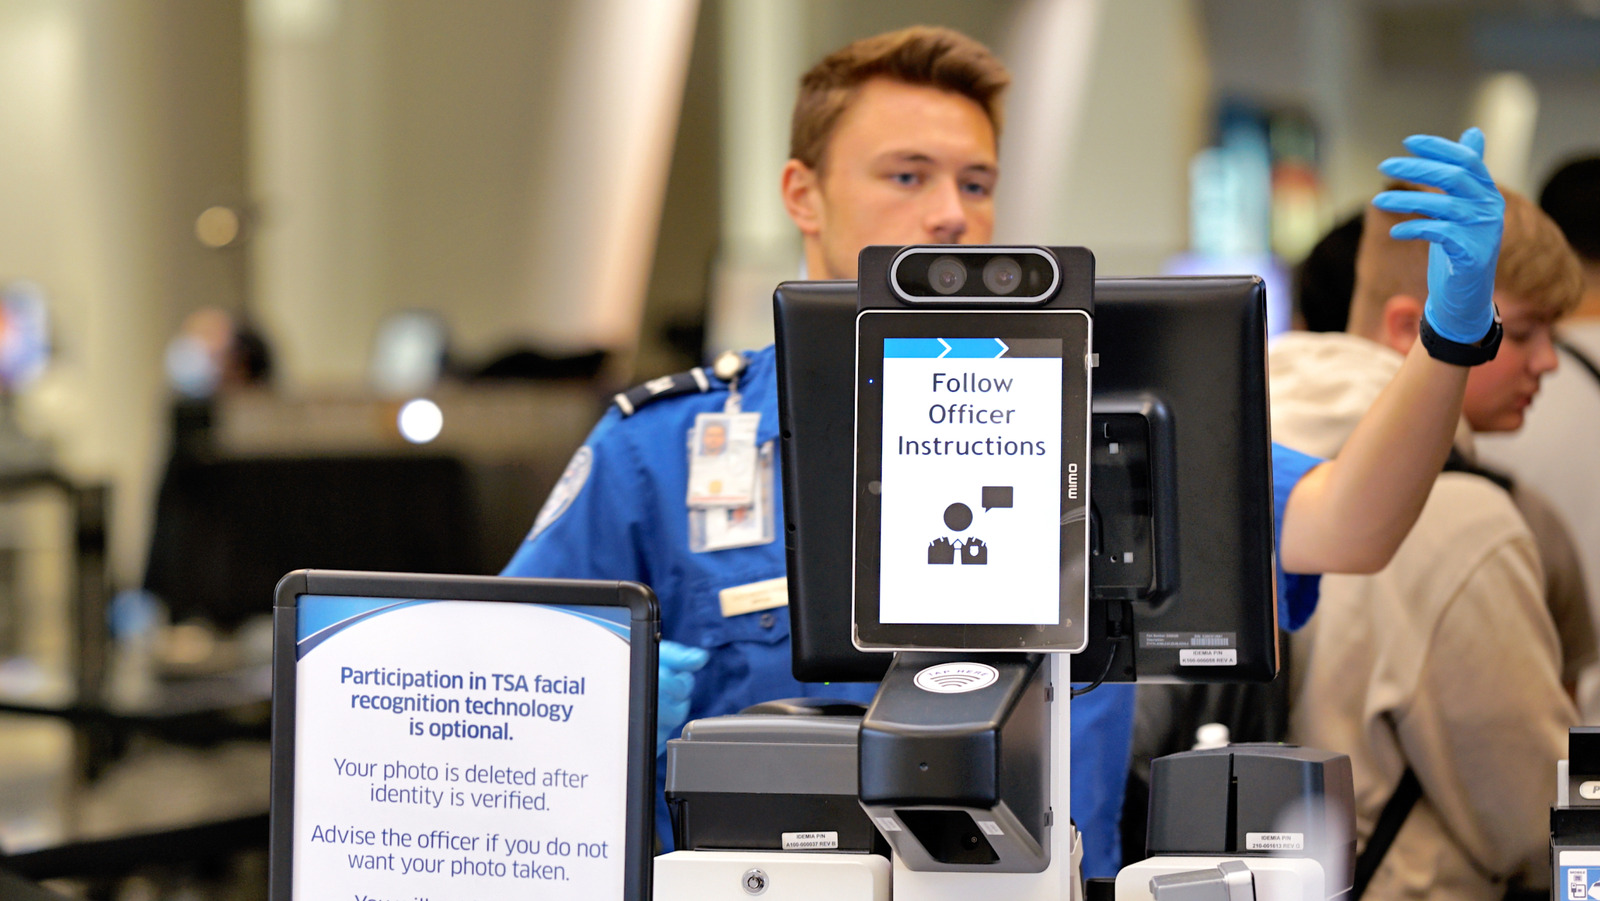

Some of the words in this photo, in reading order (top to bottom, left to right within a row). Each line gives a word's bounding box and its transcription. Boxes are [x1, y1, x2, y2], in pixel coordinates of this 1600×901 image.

[932, 372, 1013, 392] Follow
[929, 404, 1015, 424] Officer
[898, 436, 1046, 456] Instructions
[1068, 463, 1078, 499] mimo
[341, 666, 463, 690] Participation
[469, 672, 486, 690] in
[492, 674, 529, 692] TSA
[534, 675, 585, 695] facial
[351, 693, 459, 714] recognition
[465, 697, 573, 722] technology
[409, 717, 424, 736] is
[429, 720, 513, 740] optional.
[333, 758, 377, 778] Your
[383, 761, 439, 781] photo
[445, 763, 460, 782] is
[465, 764, 536, 786] deleted
[542, 769, 588, 788] after
[370, 784, 443, 808] identity
[450, 787, 464, 807] is
[471, 790, 550, 811] verified.
[311, 825, 376, 846] Advise
[381, 828, 412, 847] the
[418, 830, 479, 851] officer
[486, 834, 499, 852] if
[505, 838, 541, 856] you
[547, 838, 571, 856] do
[577, 840, 609, 859] not
[348, 853, 395, 871] want
[401, 857, 445, 874] your
[451, 857, 506, 877] photo
[512, 860, 570, 880] taken.
